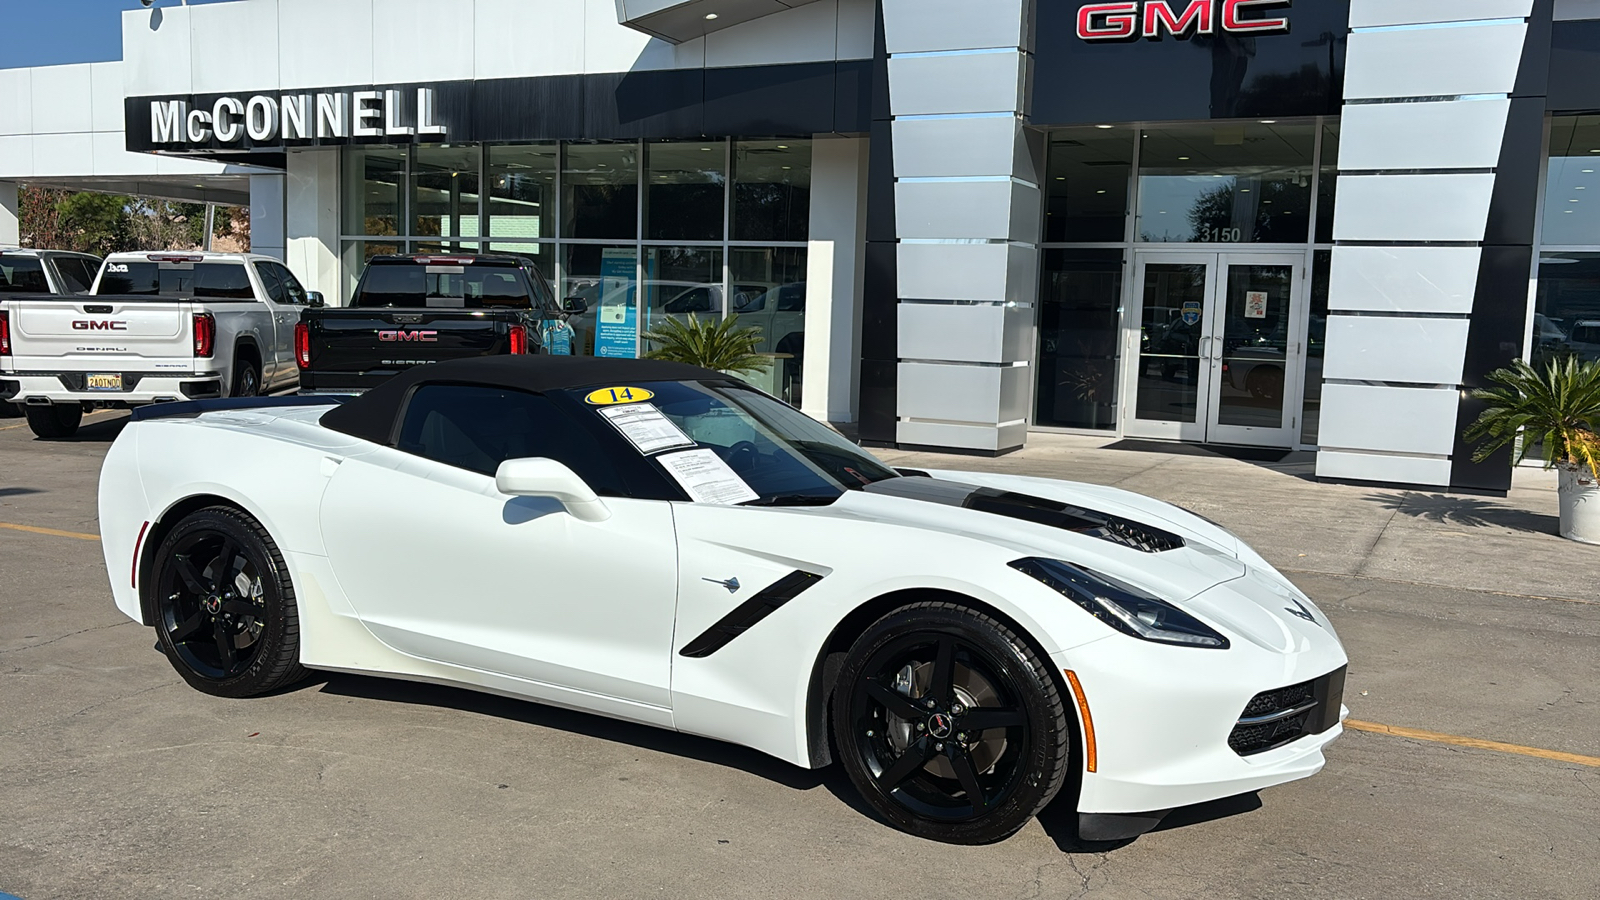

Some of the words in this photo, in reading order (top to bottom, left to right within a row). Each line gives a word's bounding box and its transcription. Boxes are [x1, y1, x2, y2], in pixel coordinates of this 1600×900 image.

[1076, 0, 1291, 39] GMC
[150, 88, 447, 143] McCONNELL
[1201, 227, 1241, 242] 3150
[72, 320, 127, 330] GMC
[378, 330, 438, 342] GMC
[606, 387, 634, 402] 14
